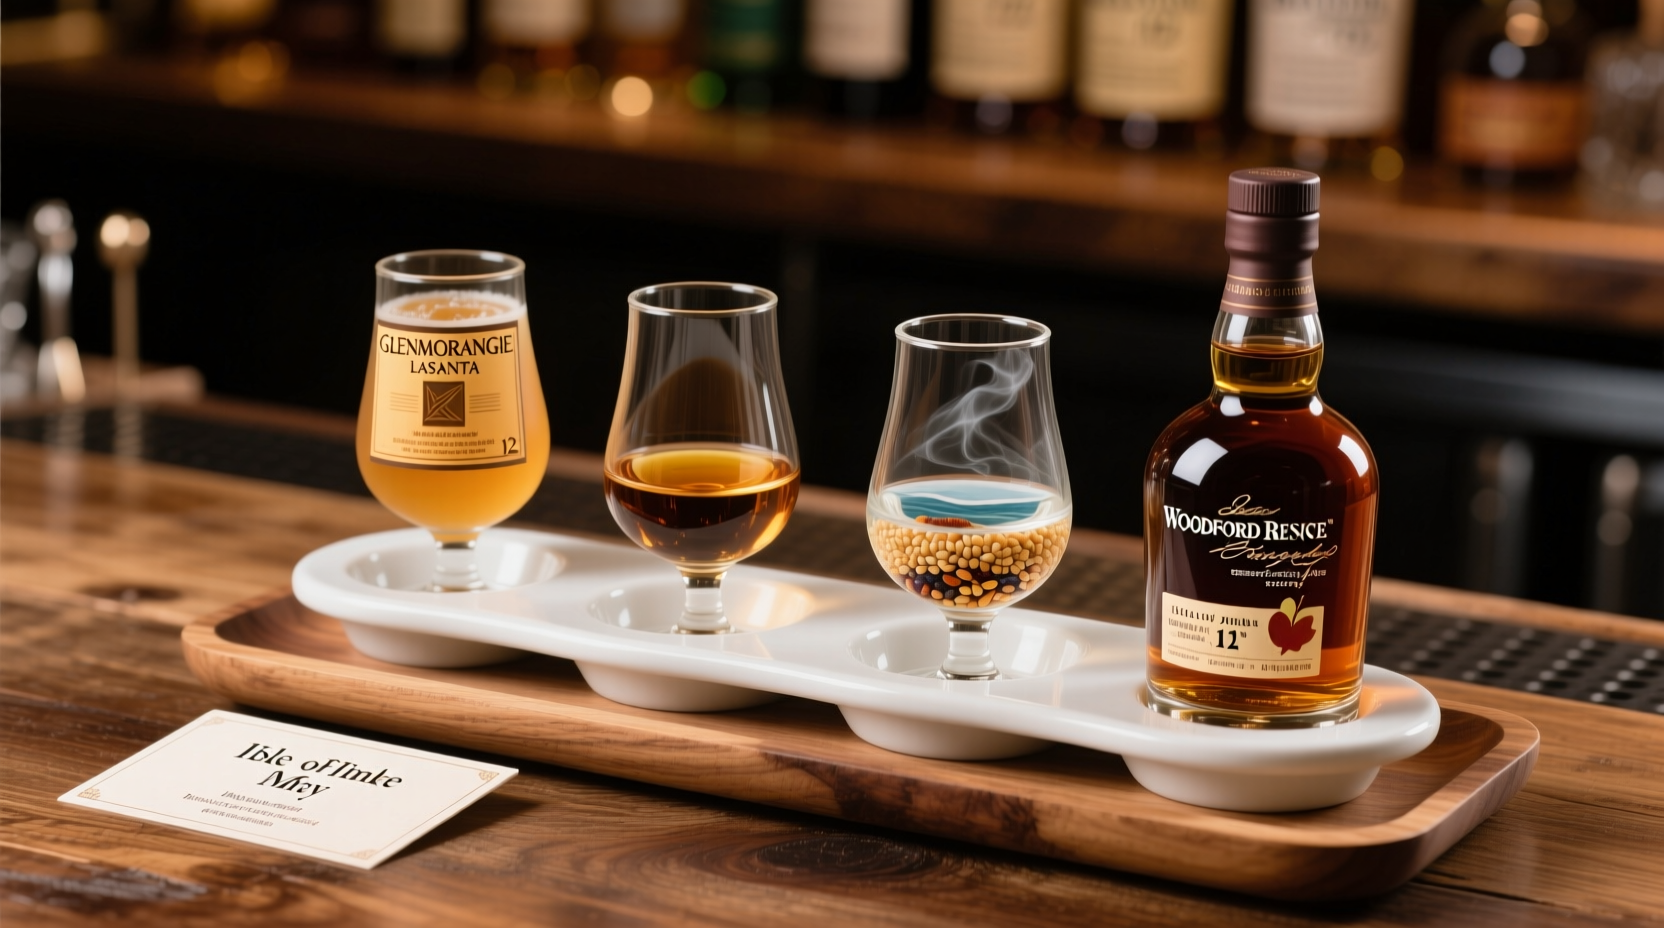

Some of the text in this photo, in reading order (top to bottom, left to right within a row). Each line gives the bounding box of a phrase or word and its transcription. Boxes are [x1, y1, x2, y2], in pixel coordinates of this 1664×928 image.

[379, 334, 513, 356] GLENMORANGIE
[410, 360, 480, 375] LASANTA
[502, 437, 519, 455] 12
[1163, 505, 1261, 539] WOODFORD
[1216, 629, 1239, 650] 12
